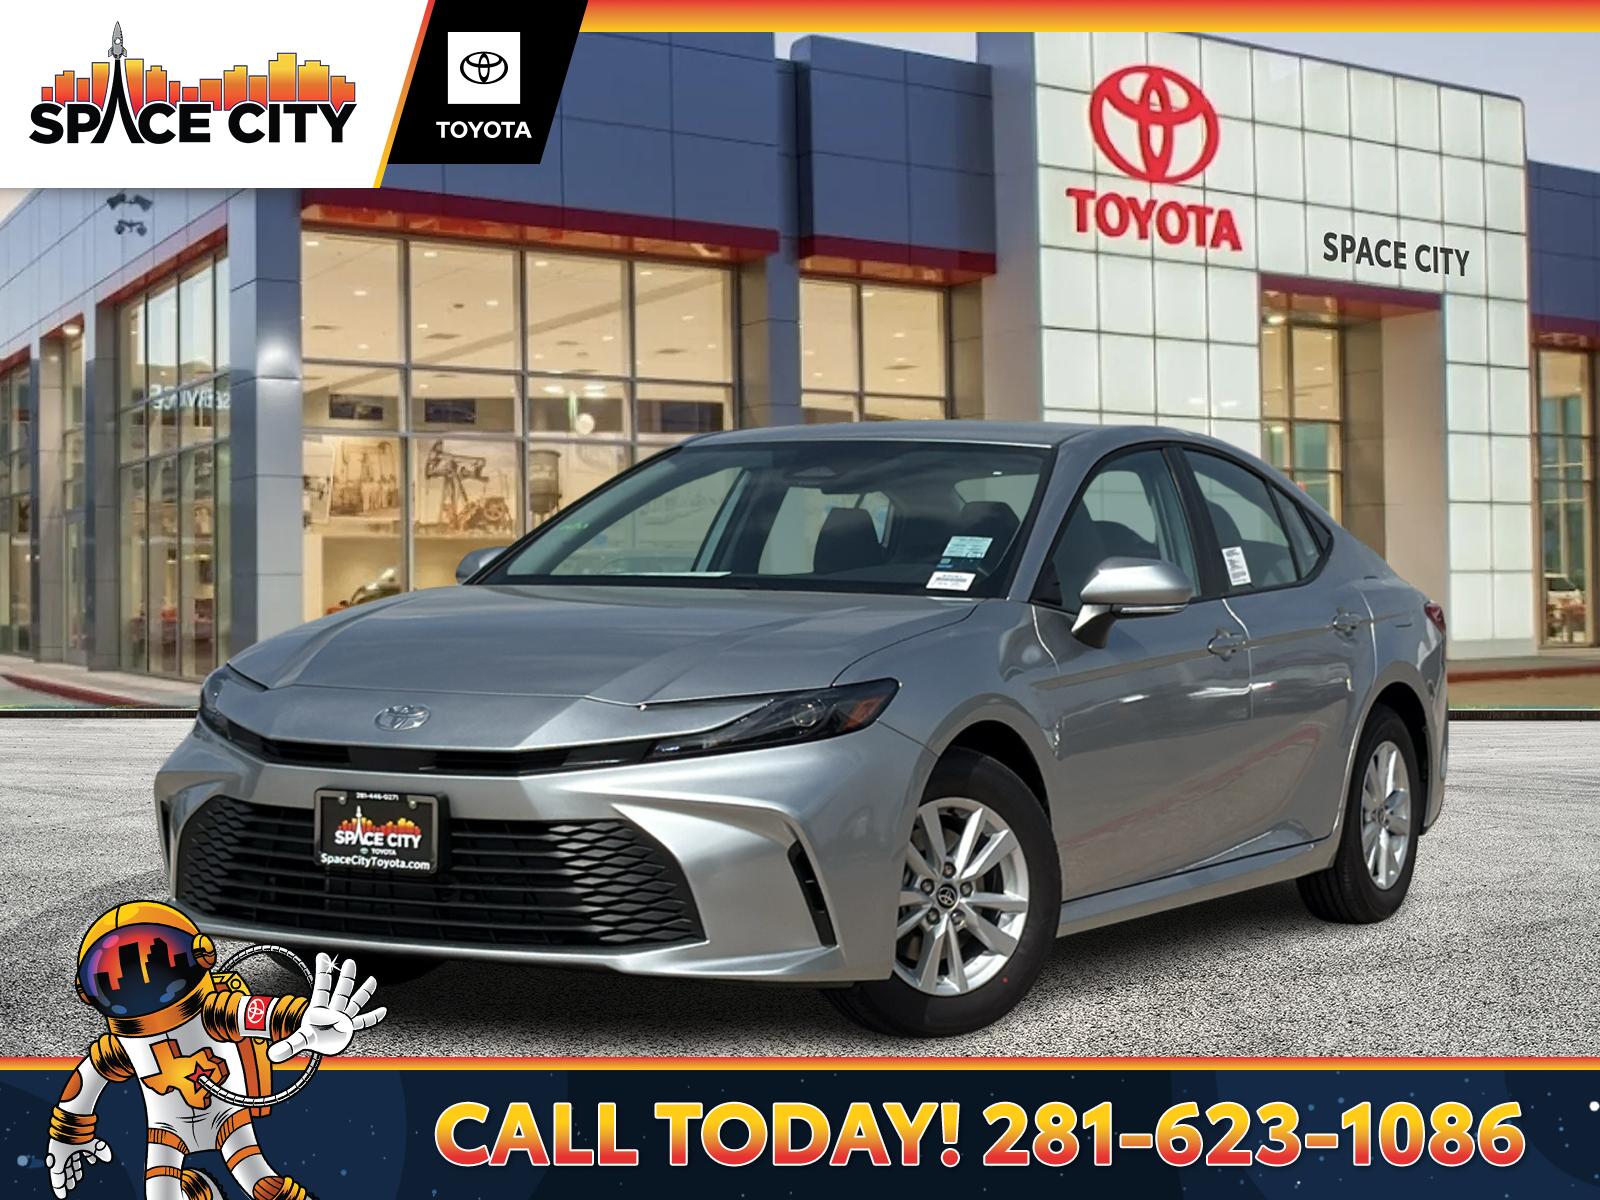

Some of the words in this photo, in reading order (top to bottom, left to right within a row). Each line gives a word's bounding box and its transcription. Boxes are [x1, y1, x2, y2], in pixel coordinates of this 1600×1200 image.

[1065, 187, 1243, 251] TOYOTA
[1322, 231, 1407, 270] SPACE
[1414, 244, 1470, 277] CITY
[334, 827, 384, 846] SPACE
[386, 832, 422, 848] CITY
[321, 853, 431, 871] SpaceCityToyota.com
[371, 847, 397, 856] TOYOTA
